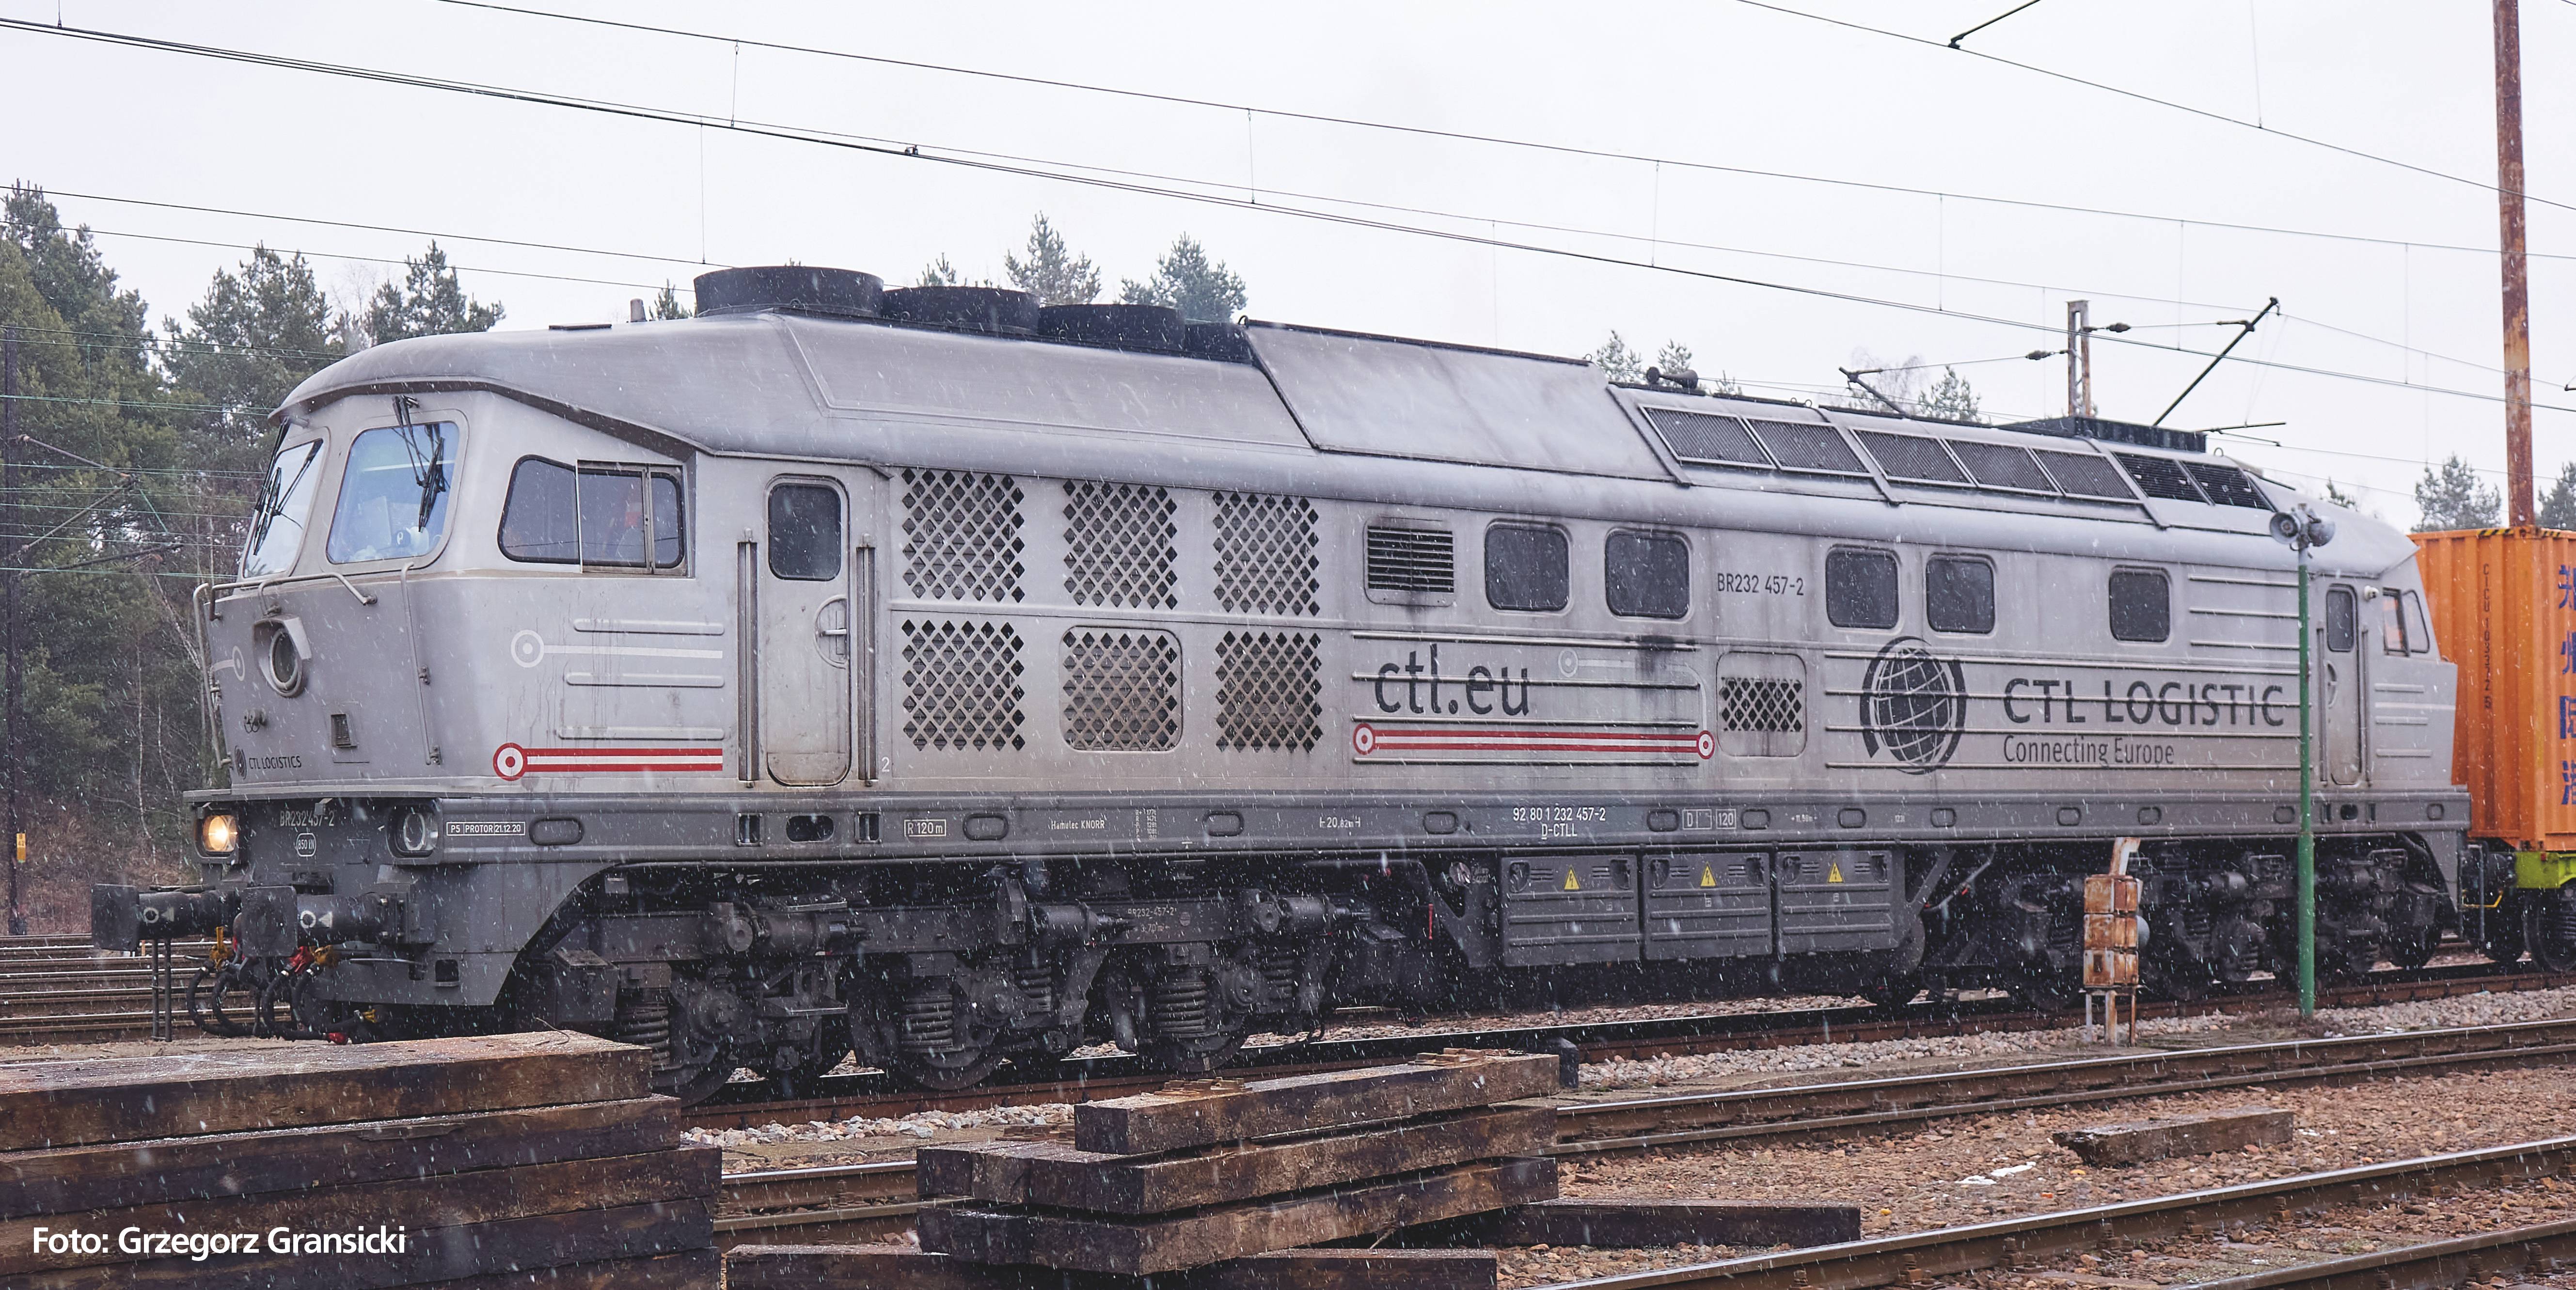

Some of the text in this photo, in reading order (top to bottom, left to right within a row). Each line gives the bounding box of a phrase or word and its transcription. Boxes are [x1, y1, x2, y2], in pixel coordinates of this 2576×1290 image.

[1717, 573, 1804, 596] BR232 457-2
[1375, 643, 1529, 716] ctl.eu
[2004, 678, 2284, 726] CTL LOGISTIC
[2004, 735, 2174, 769] Connecting Europe
[249, 755, 301, 769] CTL LOGISTICS
[881, 756, 890, 772] 2
[1513, 807, 1606, 821] 92 80 1 232 457-2
[1687, 812, 1693, 827] D
[1718, 812, 1734, 826] 120
[495, 824, 521, 833] 21.12.20
[908, 822, 943, 834] R 120 m
[1051, 819, 1105, 830] Hamulec KNORR
[1541, 823, 1577, 839] D-CTLL
[298, 839, 307, 850] 850
